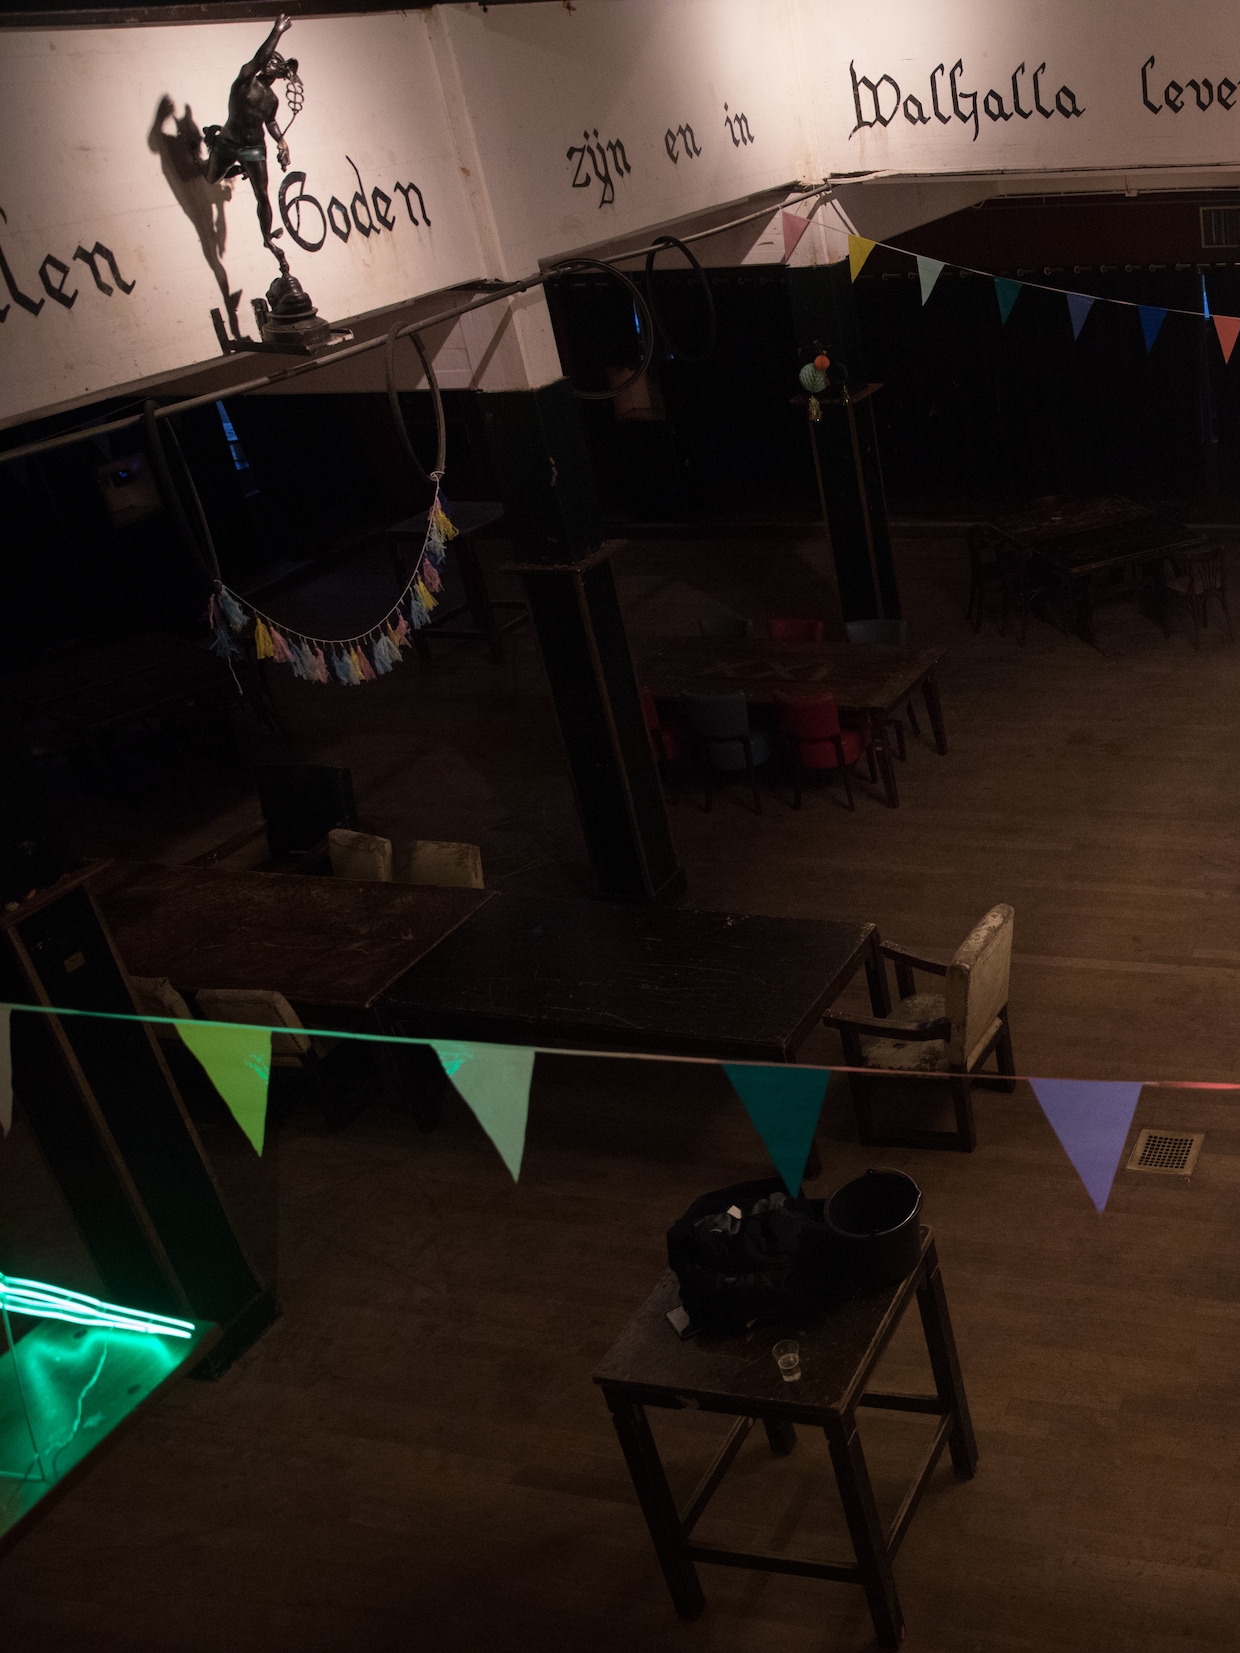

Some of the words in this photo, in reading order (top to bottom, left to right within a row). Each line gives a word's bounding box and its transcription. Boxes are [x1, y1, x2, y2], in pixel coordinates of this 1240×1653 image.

[664, 123, 702, 165] en
[724, 101, 755, 148] in
[848, 58, 1086, 142] Walhalla
[0, 205, 136, 323] len
[278, 155, 431, 253] Goden
